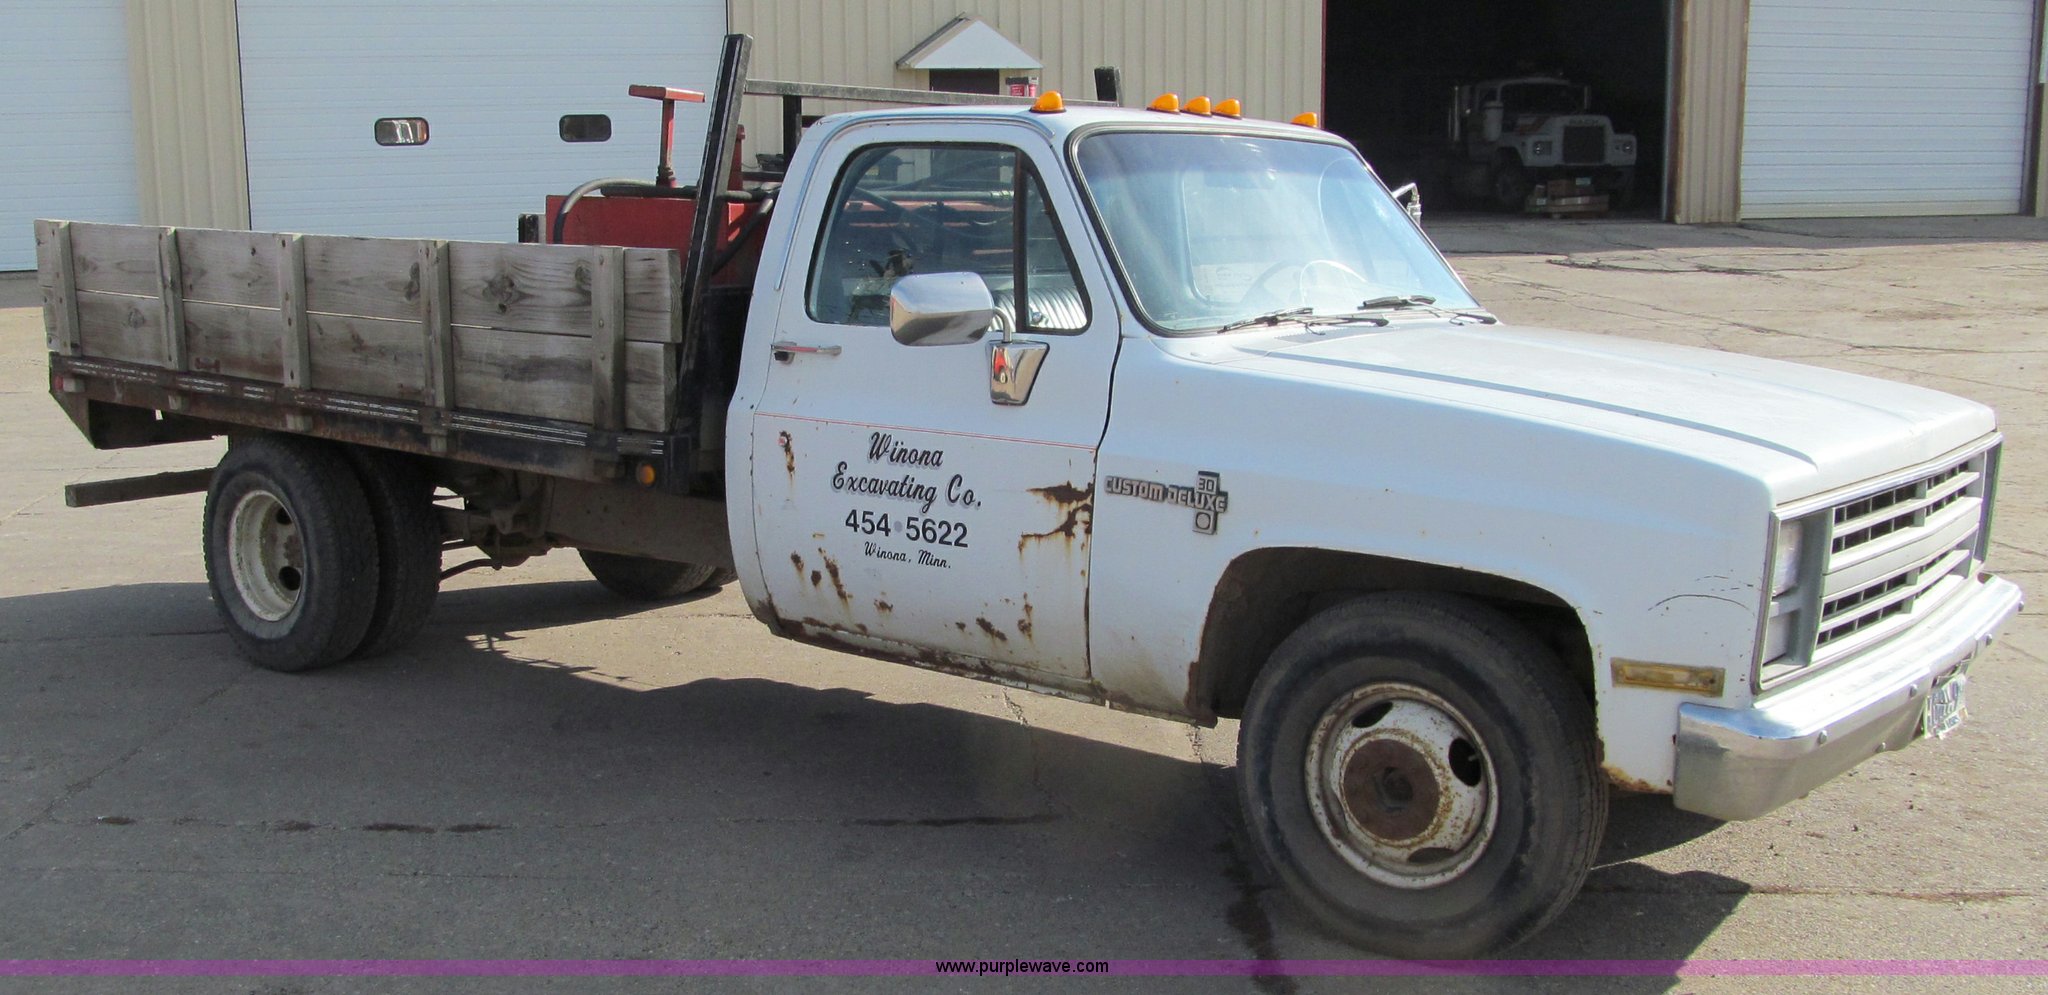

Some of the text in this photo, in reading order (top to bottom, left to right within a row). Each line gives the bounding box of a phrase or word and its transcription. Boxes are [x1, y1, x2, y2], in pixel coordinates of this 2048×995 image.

[868, 431, 944, 468] Winona
[832, 461, 982, 514] Excavating Co.
[1104, 475, 1228, 512] CUSTOM DELUXE
[1198, 477, 1215, 492] 30
[864, 541, 951, 569] Winona, Minn.
